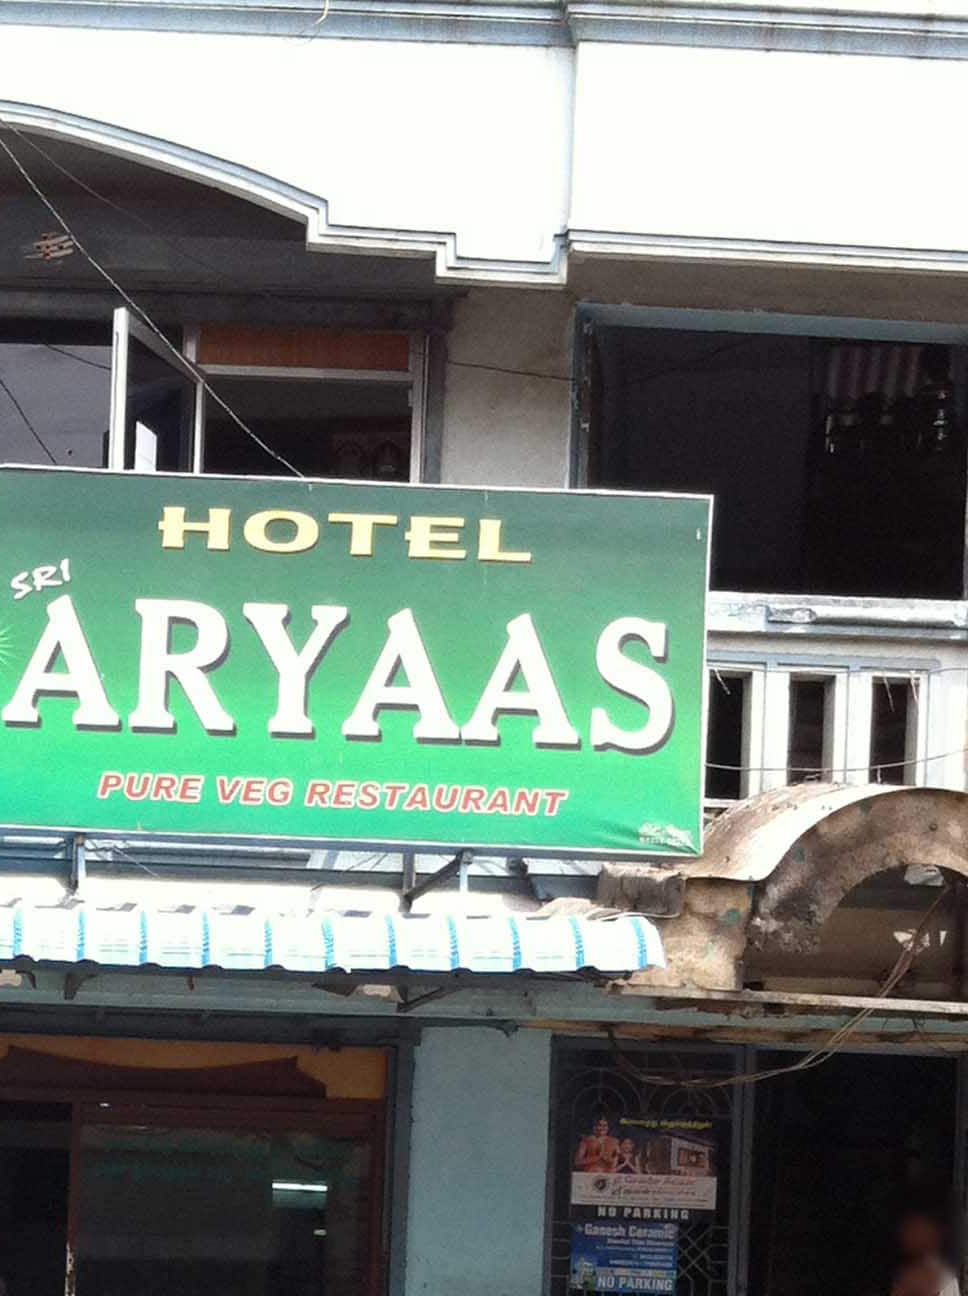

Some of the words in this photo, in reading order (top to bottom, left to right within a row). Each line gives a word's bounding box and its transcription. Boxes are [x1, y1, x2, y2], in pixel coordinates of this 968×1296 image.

[159, 506, 532, 564] HOTEL
[10, 559, 71, 599] SRI
[1, 594, 675, 754] ARYAAS
[97, 772, 204, 803] PURE
[216, 777, 292, 807] VEG
[305, 781, 569, 817] RESTAURANT
[584, 1223, 626, 1238] Ganesh
[597, 1206, 617, 1217] NO
[623, 1207, 689, 1220] PARKING
[597, 1276, 615, 1289] NO
[619, 1277, 673, 1291] PARKING
